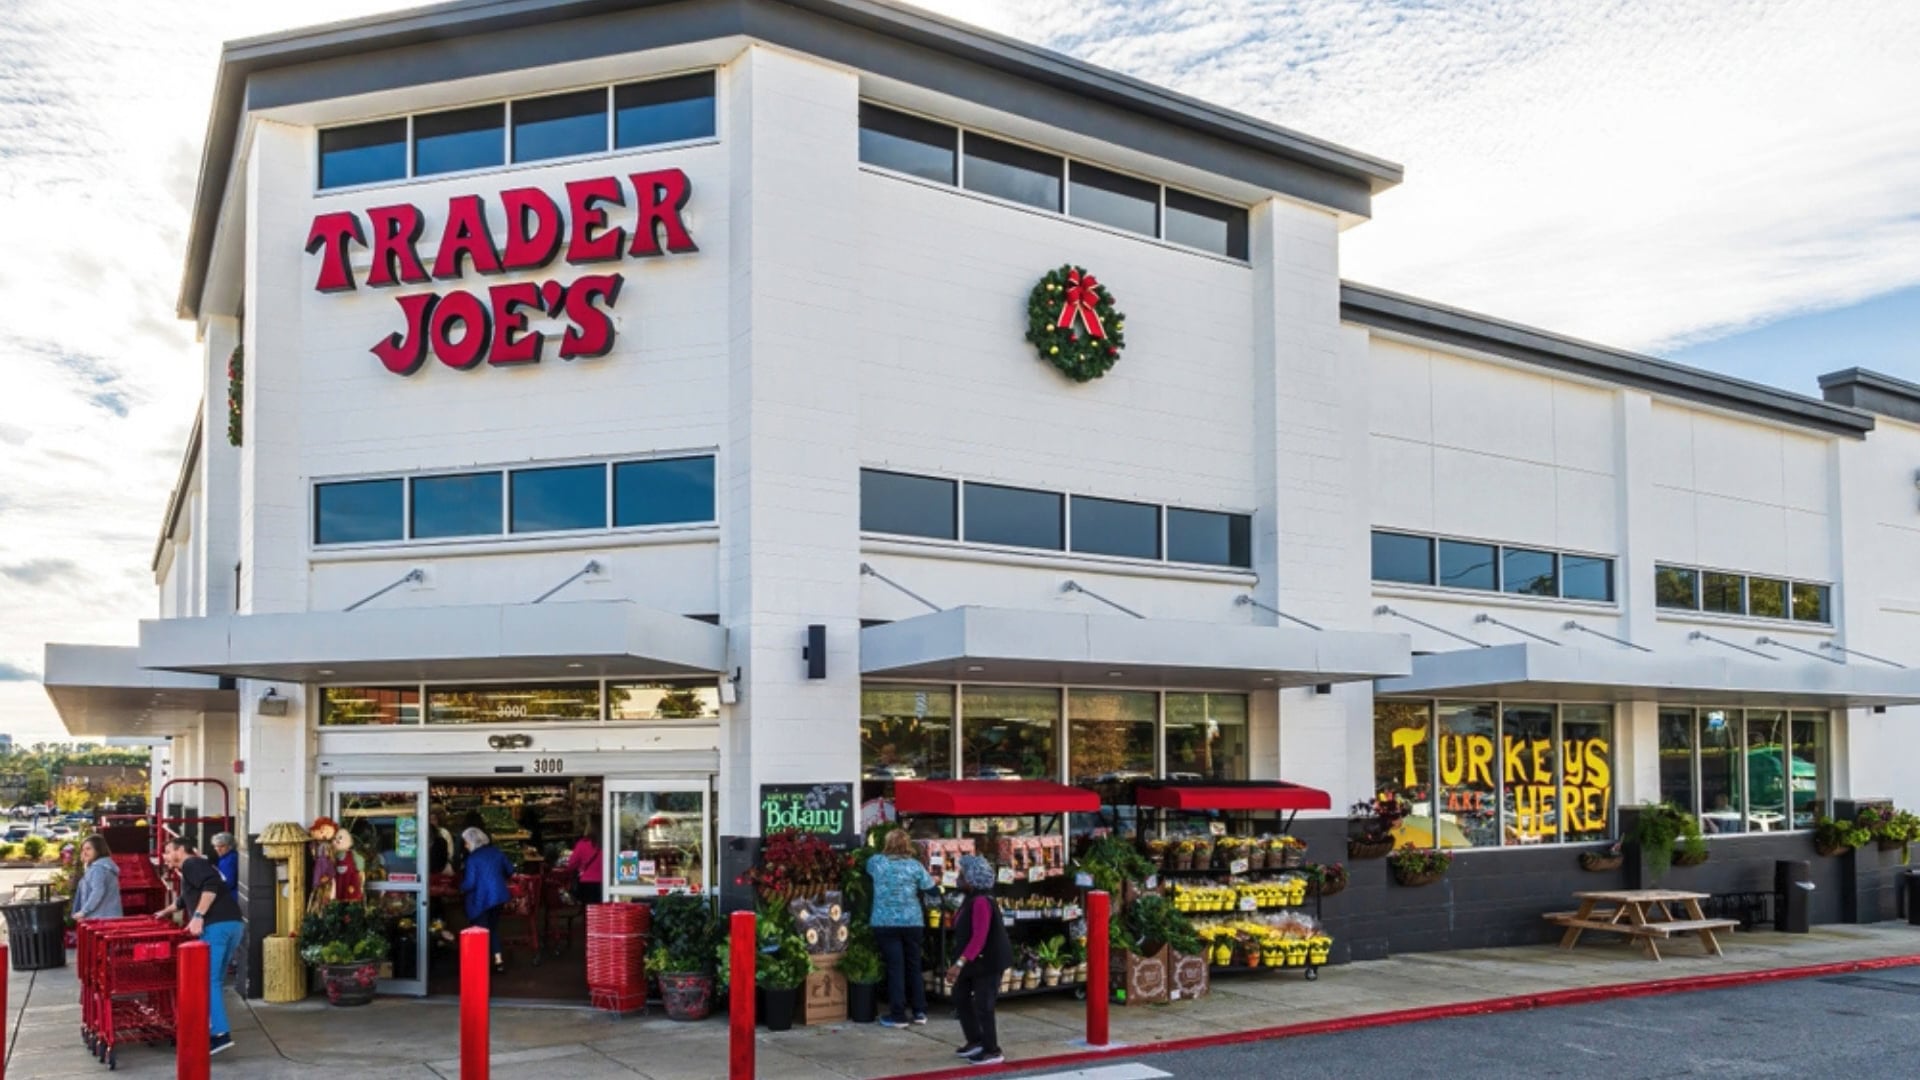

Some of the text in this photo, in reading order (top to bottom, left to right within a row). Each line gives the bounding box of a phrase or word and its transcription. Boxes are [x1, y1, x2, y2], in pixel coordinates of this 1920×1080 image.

[305, 168, 699, 292] TRADER
[369, 272, 625, 376] JOE'S
[496, 704, 527, 717] 3000
[533, 758, 563, 773] 3000
[1391, 725, 1611, 789] TURKEYS
[1514, 785, 1612, 837] HERE!
